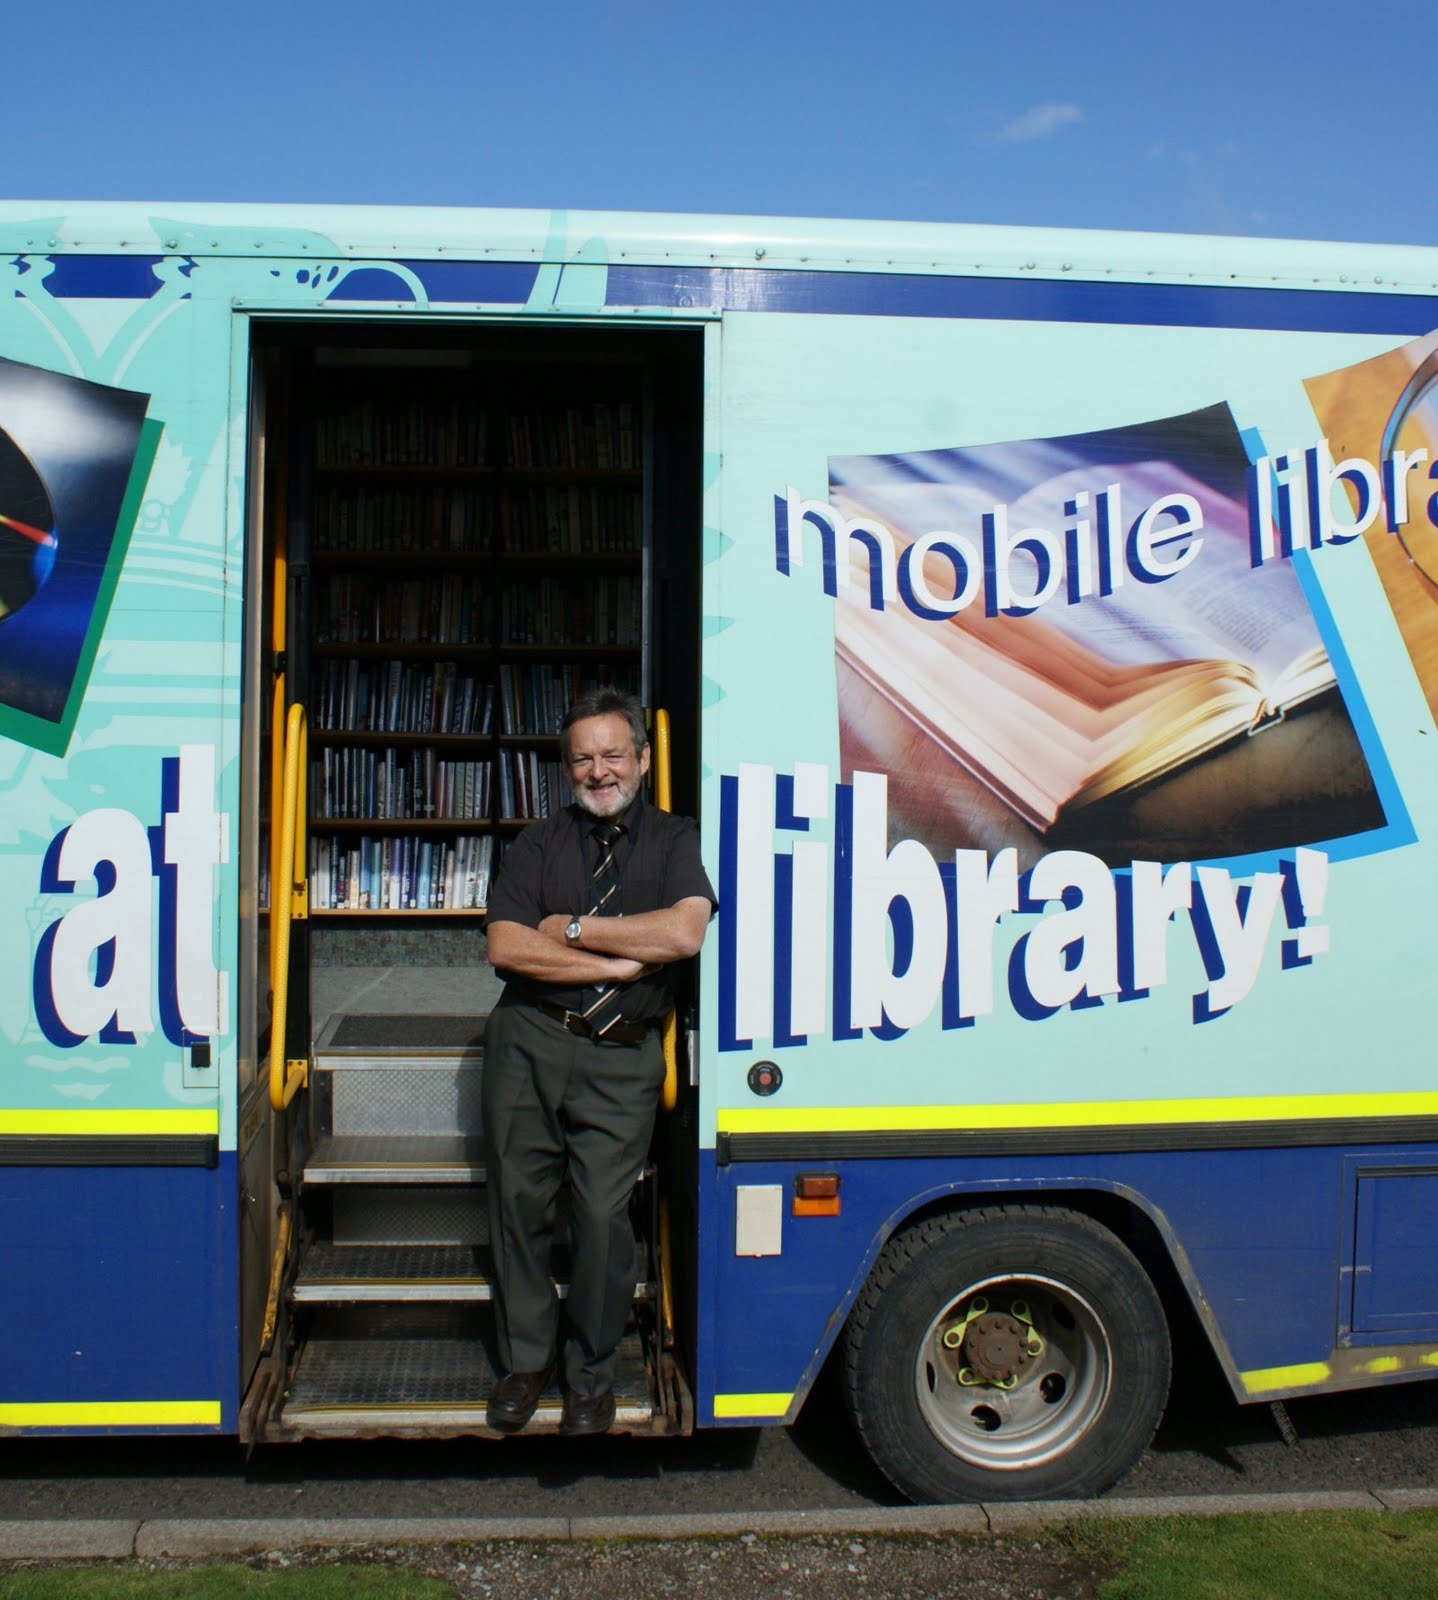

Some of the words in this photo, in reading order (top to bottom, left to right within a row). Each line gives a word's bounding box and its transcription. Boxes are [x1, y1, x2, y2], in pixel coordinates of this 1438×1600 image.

[775, 484, 1204, 621] mobile
[1246, 439, 1438, 568] libr
[34, 745, 229, 1048] at
[718, 763, 1329, 1052] library!
